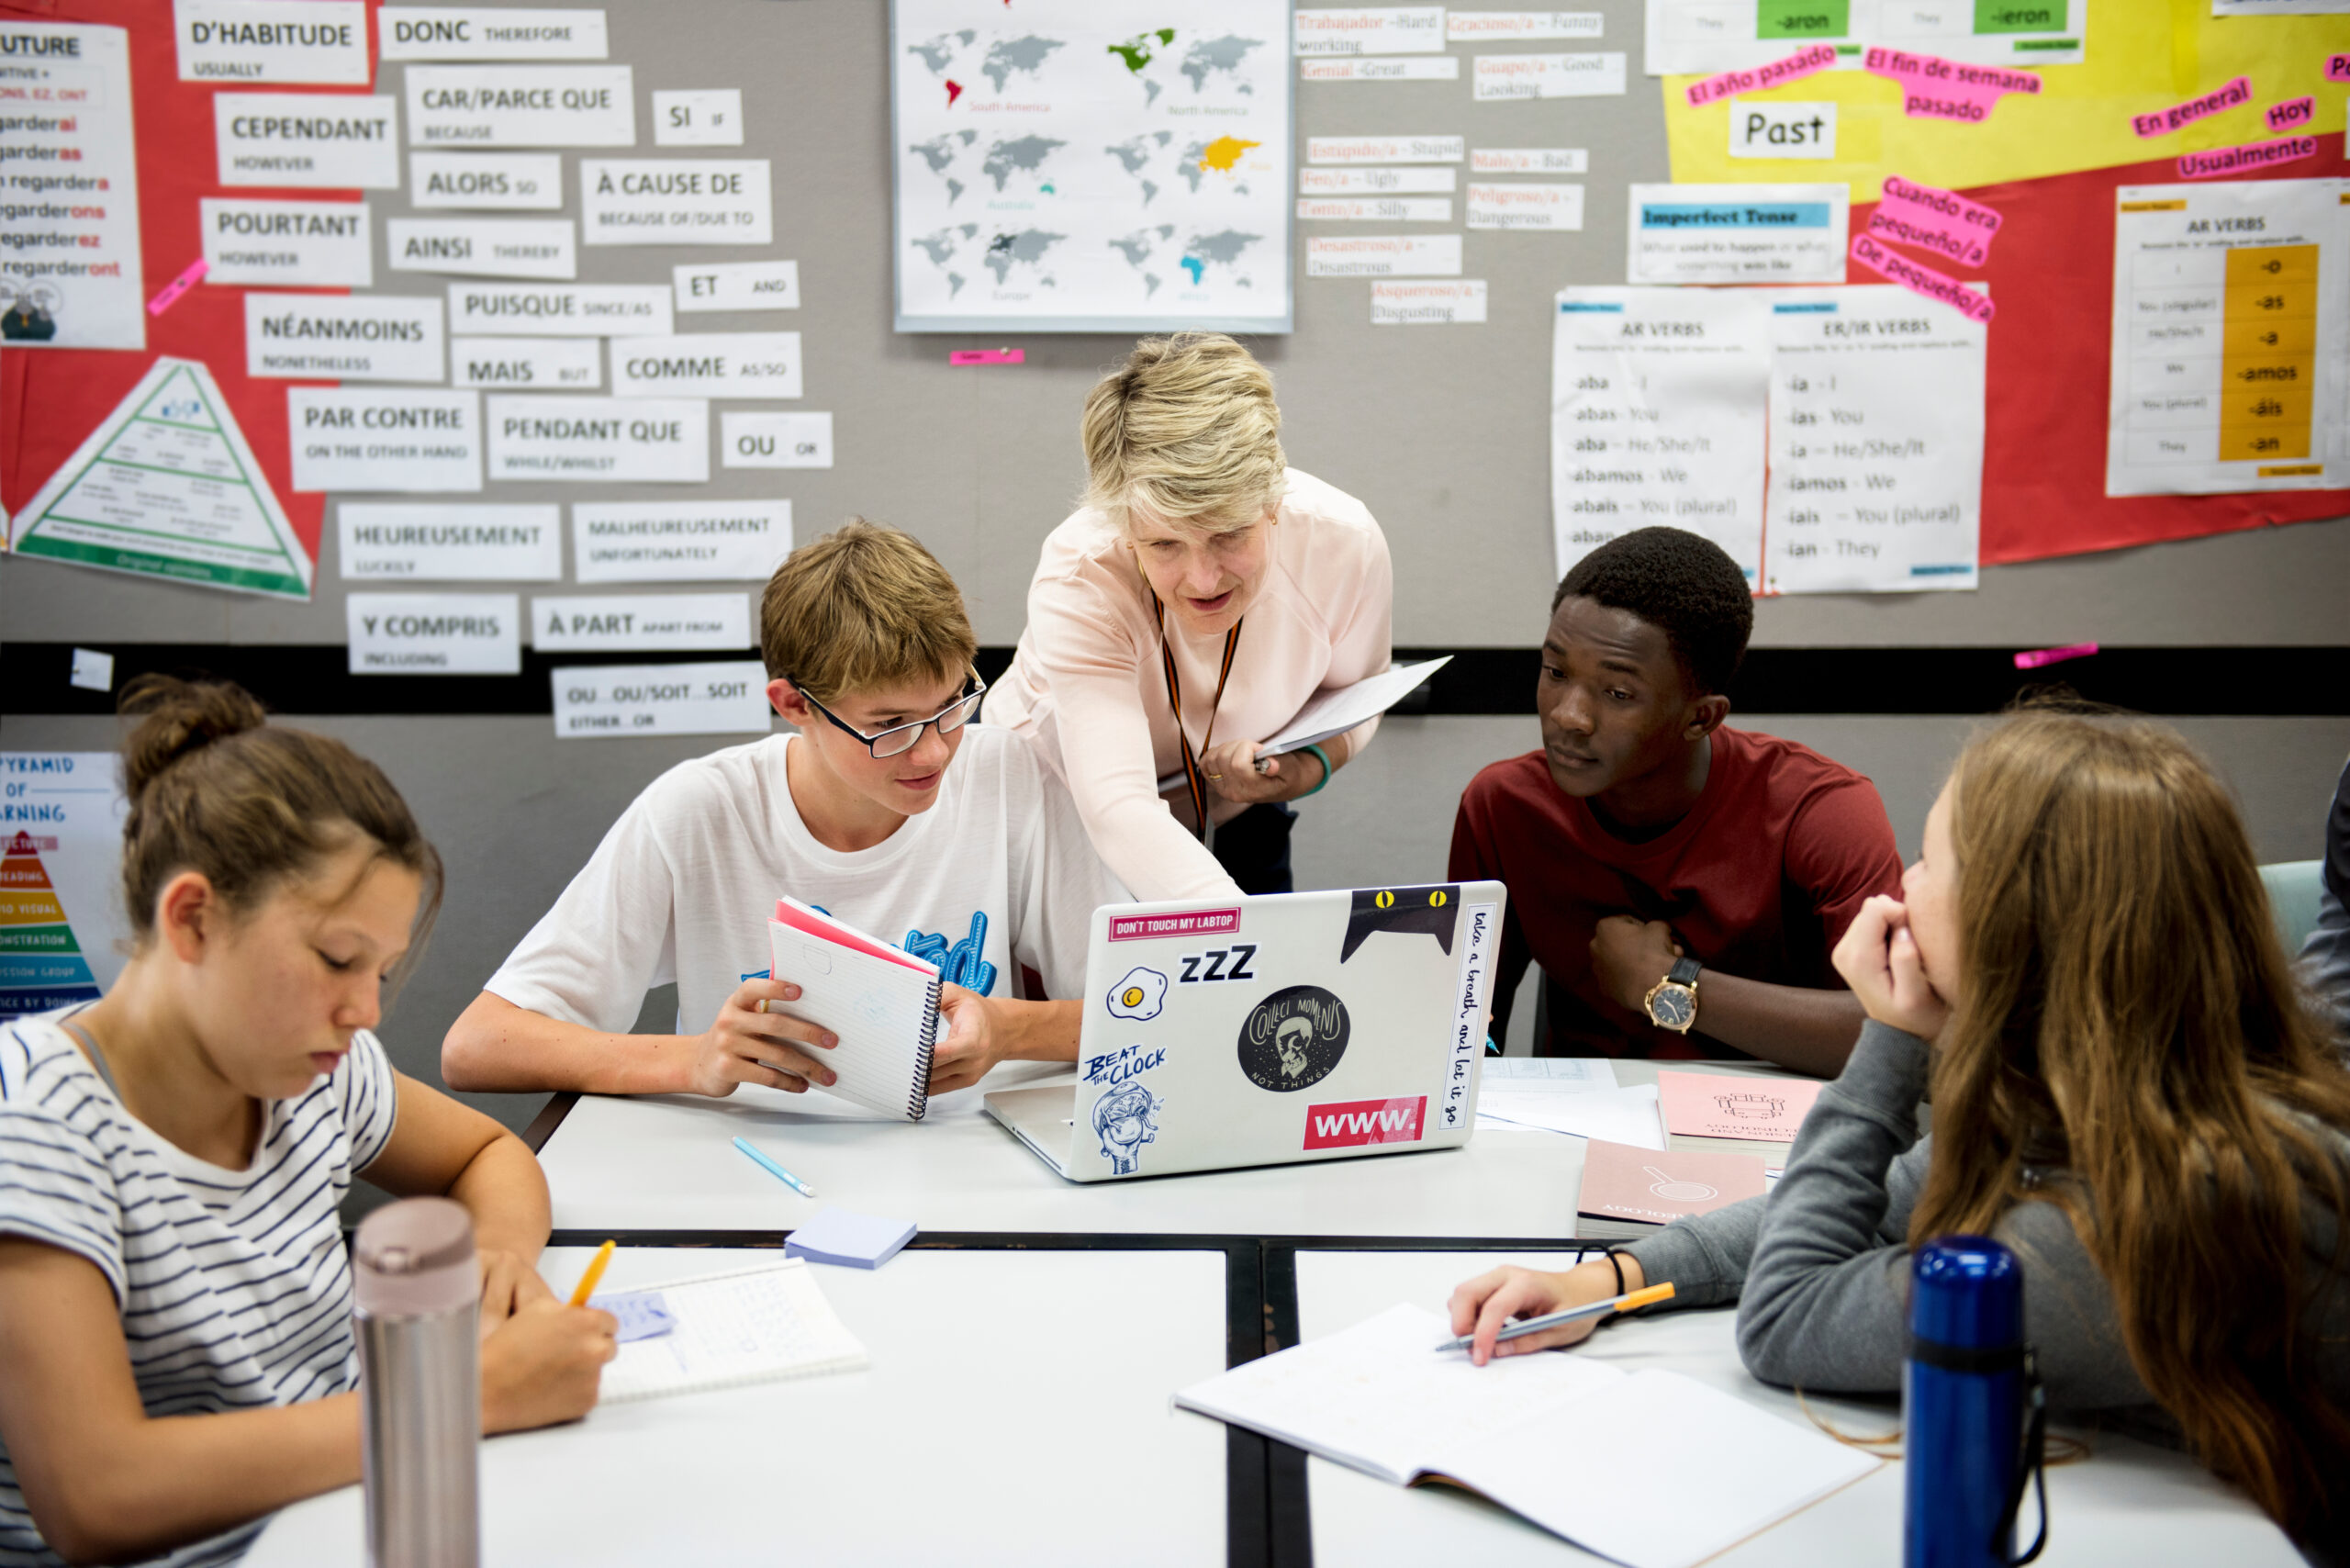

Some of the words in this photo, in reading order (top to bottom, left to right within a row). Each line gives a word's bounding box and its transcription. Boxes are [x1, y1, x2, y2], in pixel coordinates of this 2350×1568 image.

[395, 21, 471, 42] DONC
[486, 28, 572, 41] THEREFORE
[0, 35, 80, 55] UTURE
[194, 62, 263, 77] USUALLY
[1689, 85, 1708, 106] El
[1716, 73, 1753, 96] año
[1760, 48, 1835, 83] pasado
[1867, 50, 1886, 70] El
[1893, 50, 1919, 73] fin
[1928, 57, 1951, 78] de
[1957, 66, 2041, 94] semana
[422, 89, 554, 112] CAR/PARCE
[562, 90, 611, 112] QUE
[1905, 93, 1984, 122] pasado
[2134, 115, 2163, 137] En
[2169, 81, 2249, 129] general
[670, 107, 691, 128] SI
[712, 113, 724, 126] IF
[2267, 98, 2312, 128] Hoy
[232, 117, 386, 140] CEPENDANT
[424, 126, 492, 140] BECAUSE
[1746, 112, 1826, 146] Past
[234, 156, 313, 171] HOWEVER
[2179, 138, 2314, 175] Usualmente
[10, 174, 110, 193] regardera
[427, 173, 509, 196] ALORS
[516, 181, 537, 196] SO
[621, 174, 702, 196] CAUSE
[711, 174, 743, 195] DE
[1884, 176, 1960, 218] Cuando
[1965, 207, 1998, 231] era
[218, 213, 360, 236] POURTANT
[599, 212, 665, 226] BECAUSE
[670, 212, 728, 227] OF/DUE
[732, 212, 753, 226] TO
[1644, 209, 1739, 227] Imperfect
[1746, 208, 1797, 224] Tense
[2188, 218, 2210, 233] AR
[2215, 216, 2266, 231] VERBS
[1870, 212, 1984, 263] pequeño/a
[219, 252, 298, 265] HOWEVER
[405, 238, 472, 259] AINSI
[493, 244, 560, 259] THEREBY
[3, 260, 121, 277] regarderont
[1856, 238, 1883, 263] De
[1886, 259, 1991, 320] pequeño/a
[690, 275, 718, 297] ET
[752, 280, 786, 293] AND
[465, 295, 576, 319] PUISQUE
[583, 303, 652, 317] SINCE/AS
[262, 313, 424, 341] NÉANMOINS
[1621, 321, 1645, 338] AR
[1650, 321, 1705, 338] VERBS
[1824, 321, 1871, 340] ER/IR
[1877, 319, 1930, 335] VERBS
[263, 355, 371, 371] NONETHELESS
[468, 362, 533, 382] MAIS
[558, 368, 589, 381] BUT
[626, 357, 726, 379] COMME
[740, 364, 786, 376] AS/SO
[305, 409, 354, 428] PAR
[363, 409, 464, 429] CONTRE
[504, 419, 622, 441] PENDANT
[629, 421, 681, 442] QUE
[306, 446, 329, 459] ON
[334, 446, 362, 459] THE
[367, 446, 419, 459] OTHER
[422, 447, 468, 459] HAND
[737, 435, 775, 456] OU
[795, 442, 817, 455] OR
[504, 455, 615, 471] WHILE/WHILST
[355, 525, 543, 546] HEUREUSEMENT
[588, 518, 770, 537] MALHEUREUSEMENT
[590, 547, 718, 563] UNFORTUNATELY
[356, 559, 415, 574] LUCKILY
[363, 616, 379, 636] Y
[386, 616, 499, 639] COMPRIS
[573, 614, 633, 635] PART
[642, 622, 682, 633] APART
[686, 621, 722, 633] FROM
[364, 652, 448, 666] INCLUDING
[6, 782, 27, 797] OF
[0, 805, 65, 822] RNING
[1117, 921, 1144, 935] DON'T
[1147, 919, 1177, 932] TOUCH
[1180, 918, 1194, 931] MY
[1197, 914, 1234, 928] LABTOP
[1472, 913, 1487, 946] take
[1469, 953, 1479, 964] a
[1460, 969, 1481, 1019] breath
[1249, 1000, 1290, 1046] COLLECT
[1297, 997, 1342, 1040] MOMENTS
[1456, 1025, 1472, 1054] and
[1083, 1045, 1141, 1081] BEAT
[1091, 1071, 1109, 1086] THE
[1110, 1047, 1167, 1085] CLOCK
[1453, 1059, 1471, 1081] let
[1251, 1071, 1274, 1088] NOT
[1281, 1067, 1330, 1089] THINGS
[1450, 1085, 1465, 1100] it
[1445, 1106, 1457, 1126] go
[1602, 1204, 1685, 1219] EOLOGY
